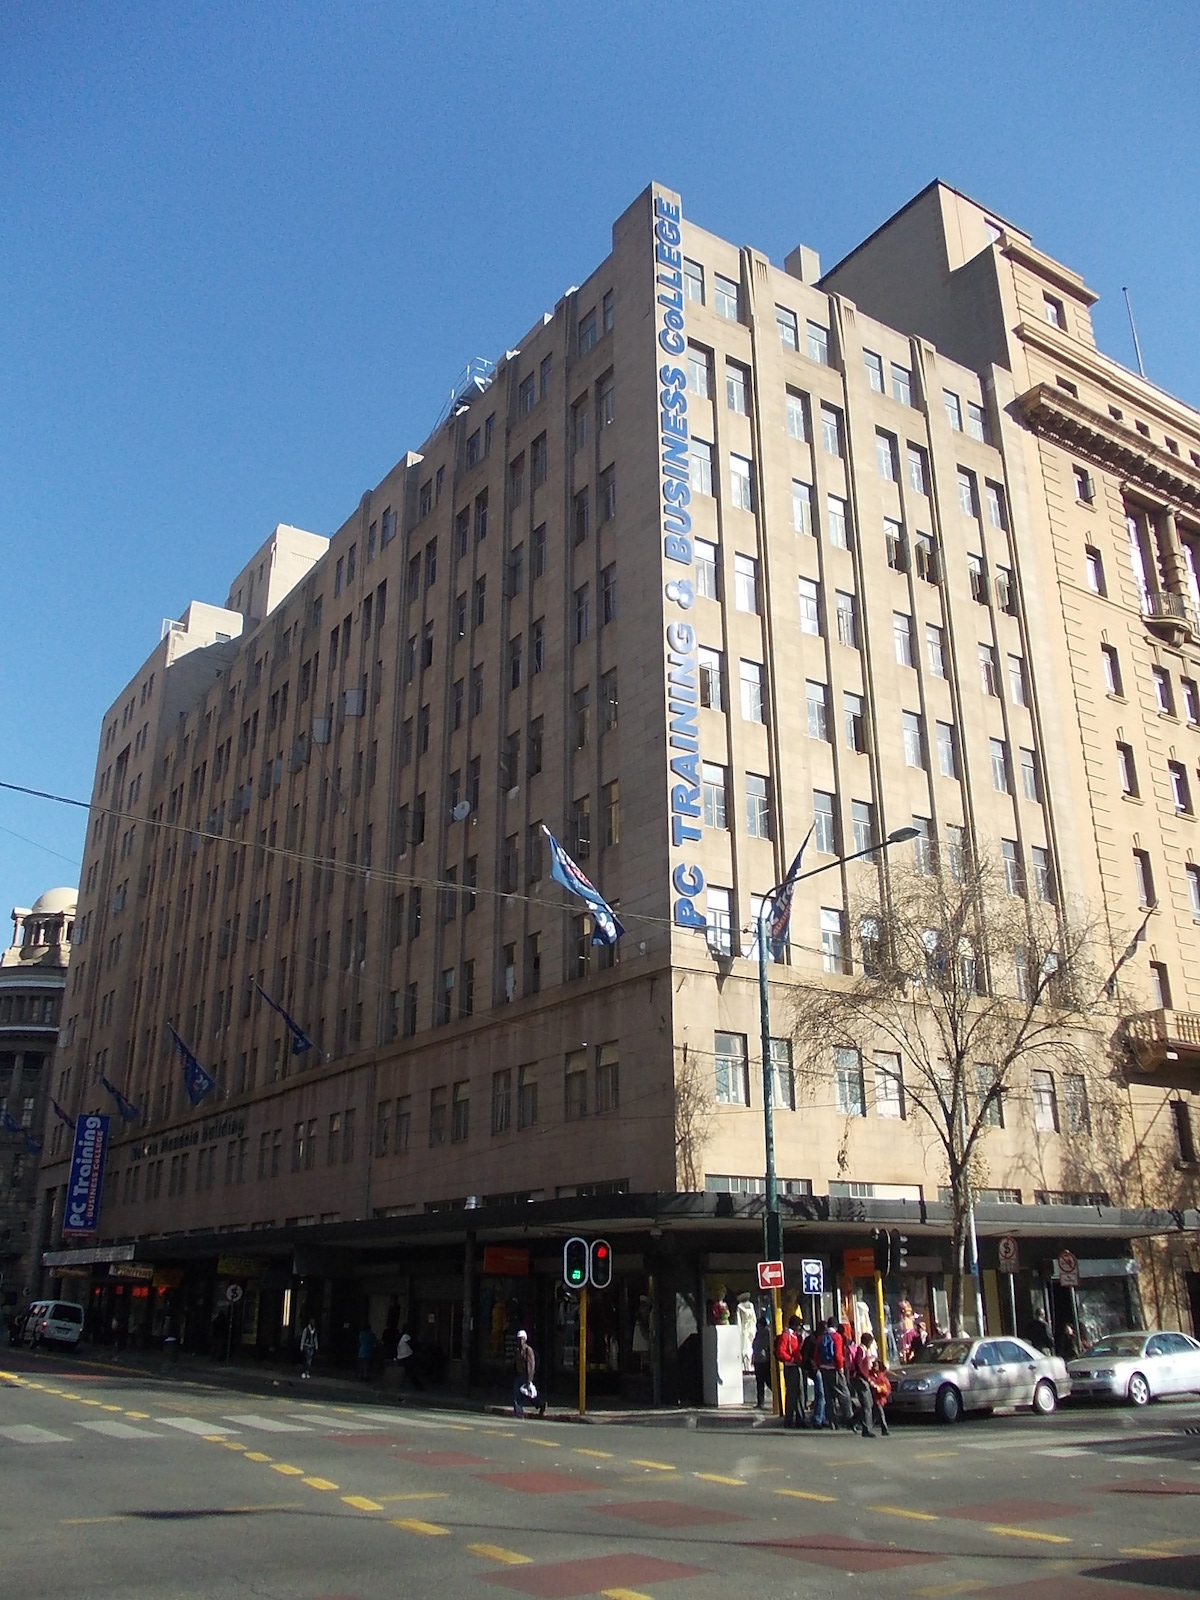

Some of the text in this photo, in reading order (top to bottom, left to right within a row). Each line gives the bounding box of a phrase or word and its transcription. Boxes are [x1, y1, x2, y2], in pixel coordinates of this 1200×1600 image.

[659, 364, 693, 566] BUSINESS
[665, 579, 695, 610] &
[668, 621, 702, 847] TRAINING
[673, 863, 707, 929] PC
[72, 1116, 101, 1197] Training
[69, 1202, 87, 1227] PC
[809, 1276, 819, 1291] R
